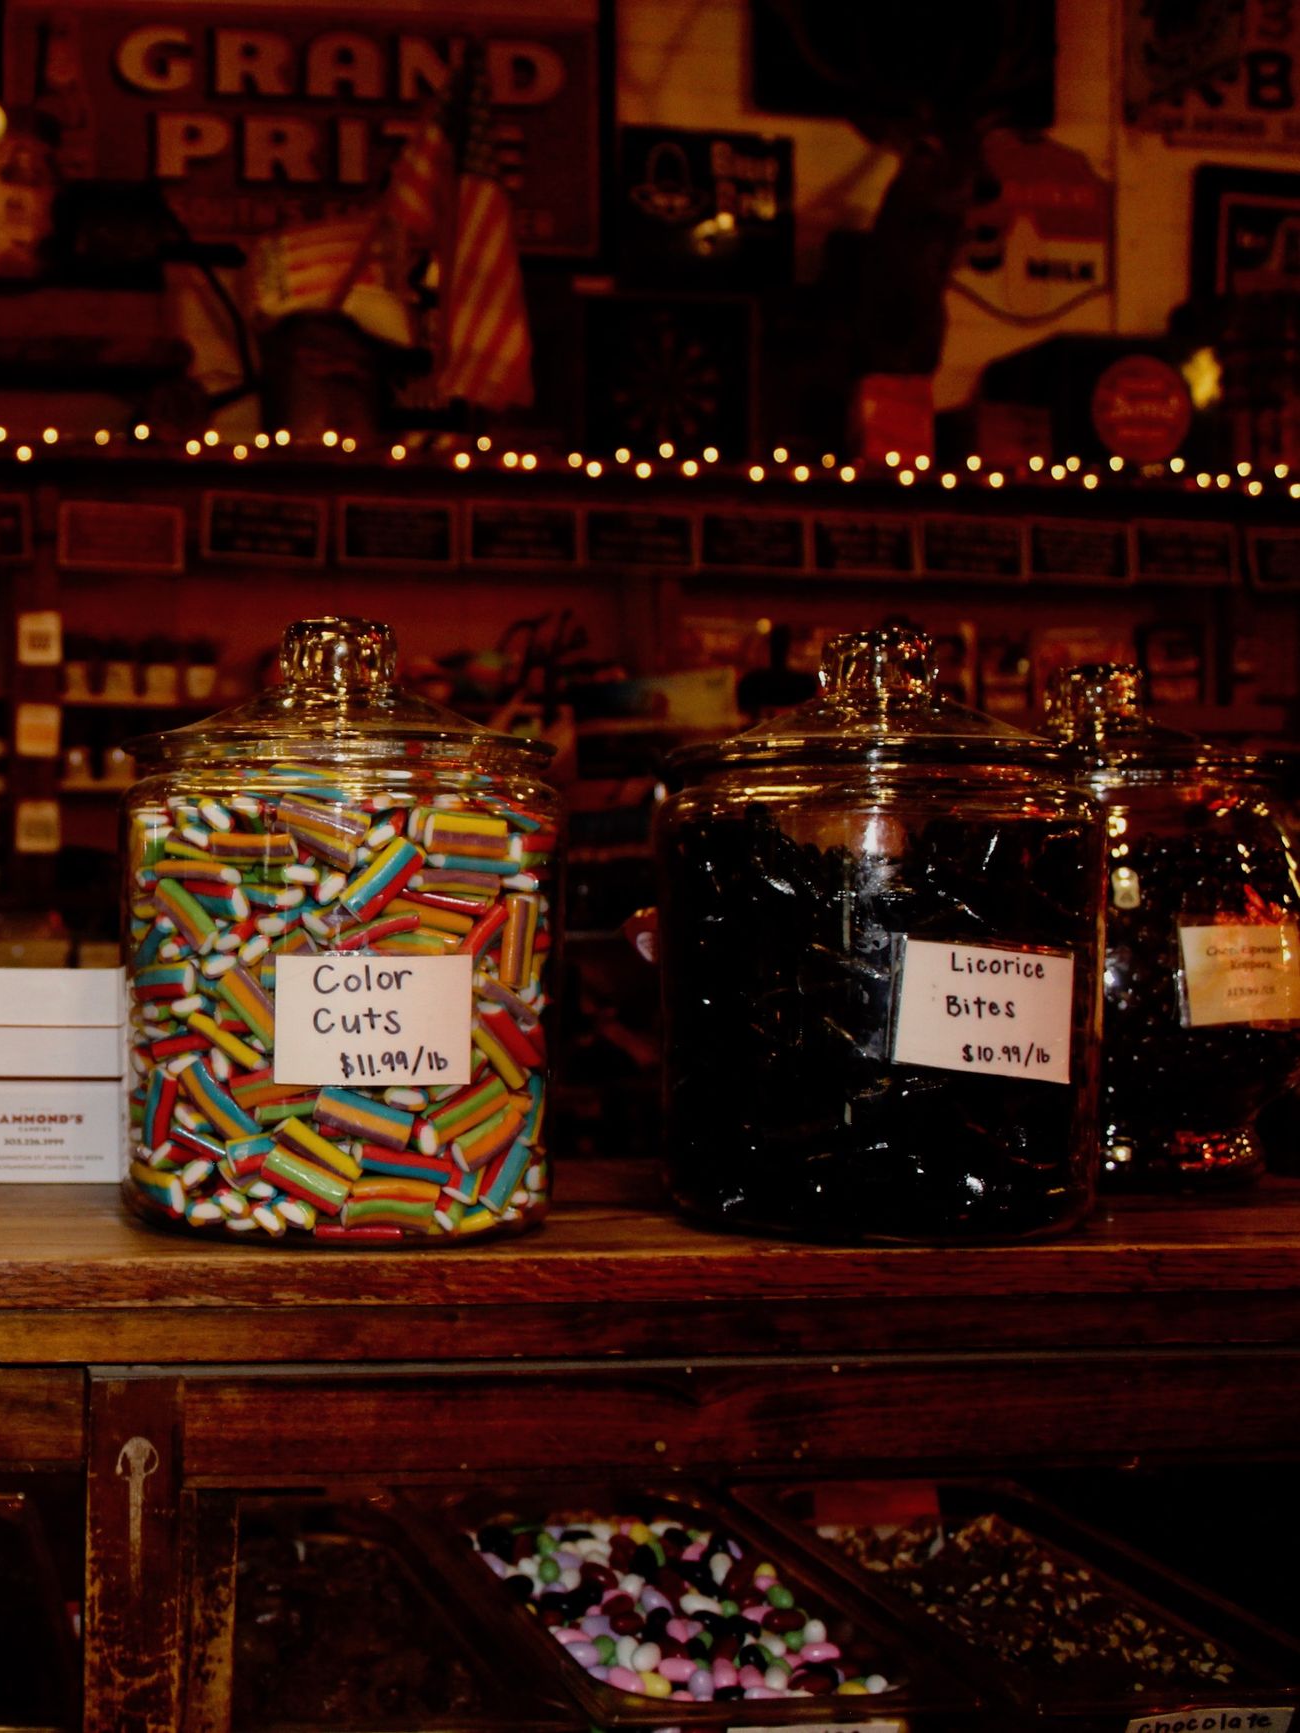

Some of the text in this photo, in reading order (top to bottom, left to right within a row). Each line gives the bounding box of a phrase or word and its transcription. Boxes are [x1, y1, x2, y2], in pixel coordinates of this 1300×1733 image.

[117, 26, 566, 105] GRAND
[951, 951, 1046, 979] Licorice
[312, 964, 413, 995] Color
[312, 1007, 402, 1035] Cuts
[945, 995, 1016, 1019] Bites
[339, 1046, 449, 1079] $11.99/lb
[961, 1042, 1051, 1067] $10.99/lb
